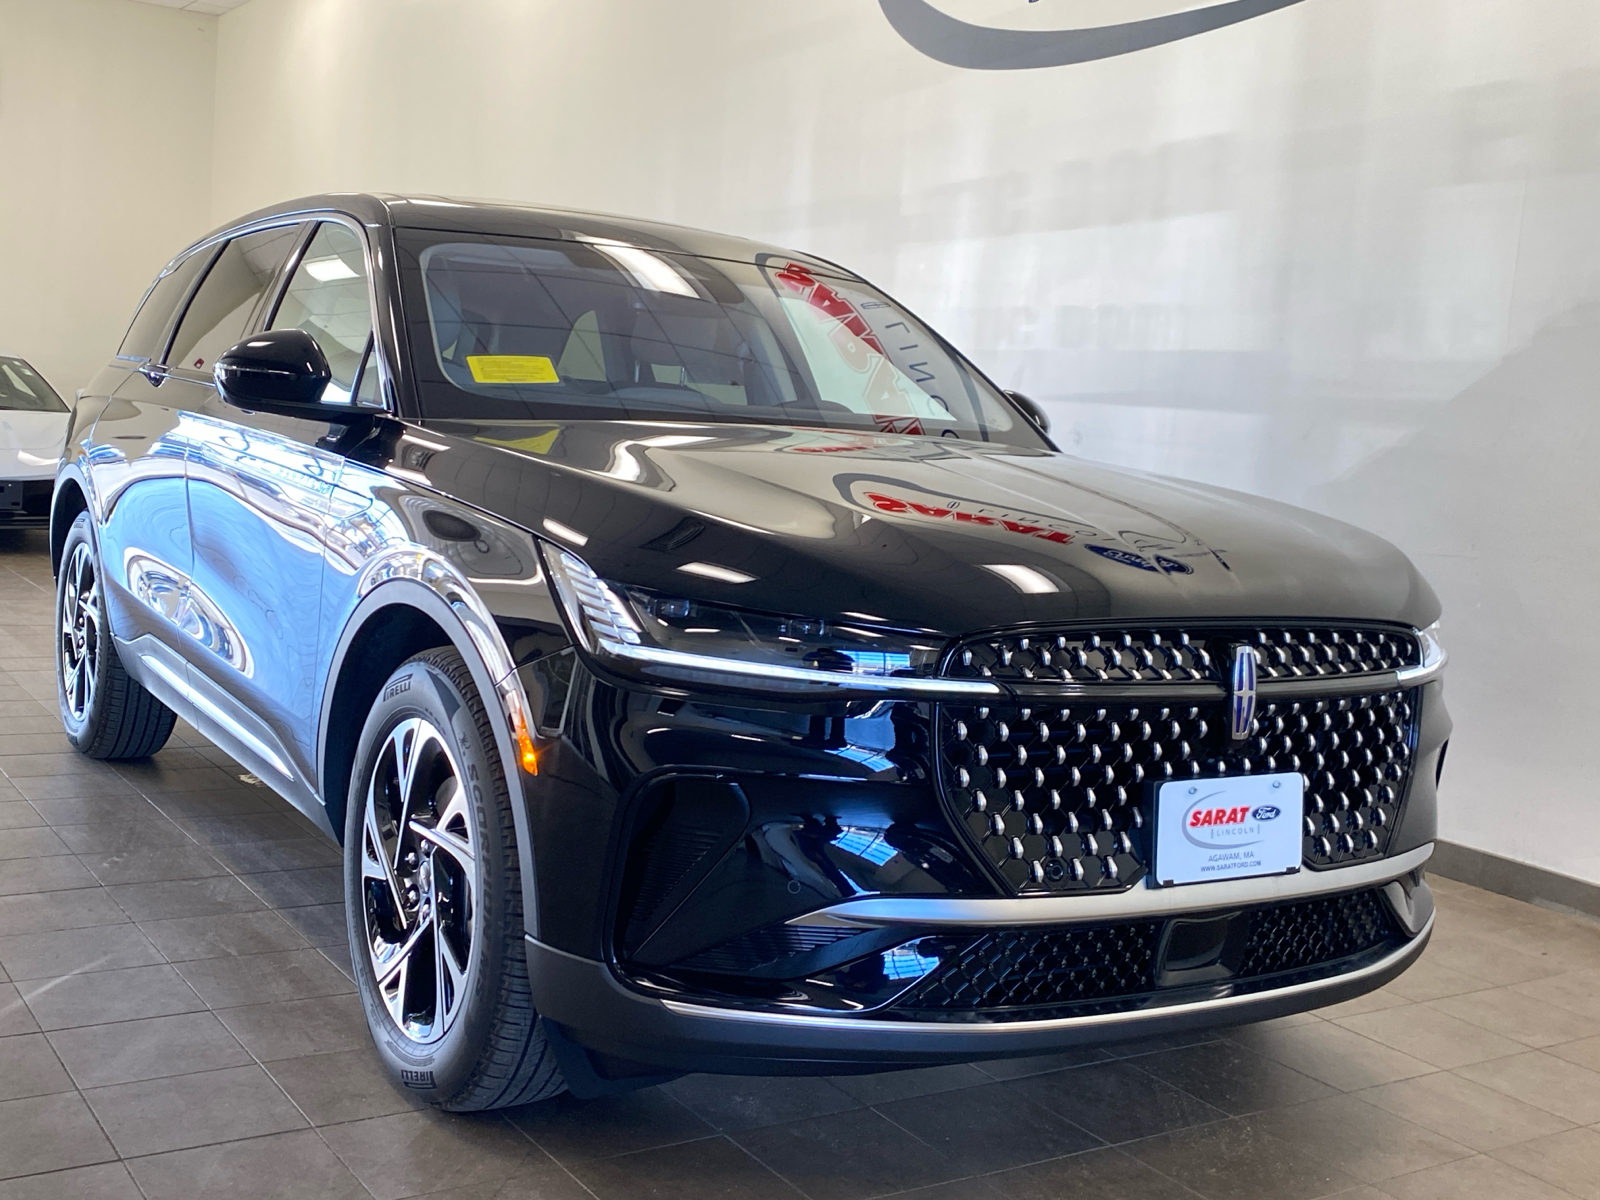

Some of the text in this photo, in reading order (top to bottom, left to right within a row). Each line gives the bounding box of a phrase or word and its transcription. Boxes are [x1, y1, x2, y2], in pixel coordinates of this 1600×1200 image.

[383, 673, 414, 702] PIRELLI
[1189, 806, 1277, 828] SARAT Ford
[1216, 827, 1255, 837] LINCOLN
[1208, 851, 1255, 862] AGAWAM, MA
[1200, 860, 1262, 872] WWW.SARATFORD.COM
[401, 1069, 438, 1090] PIRELLI
